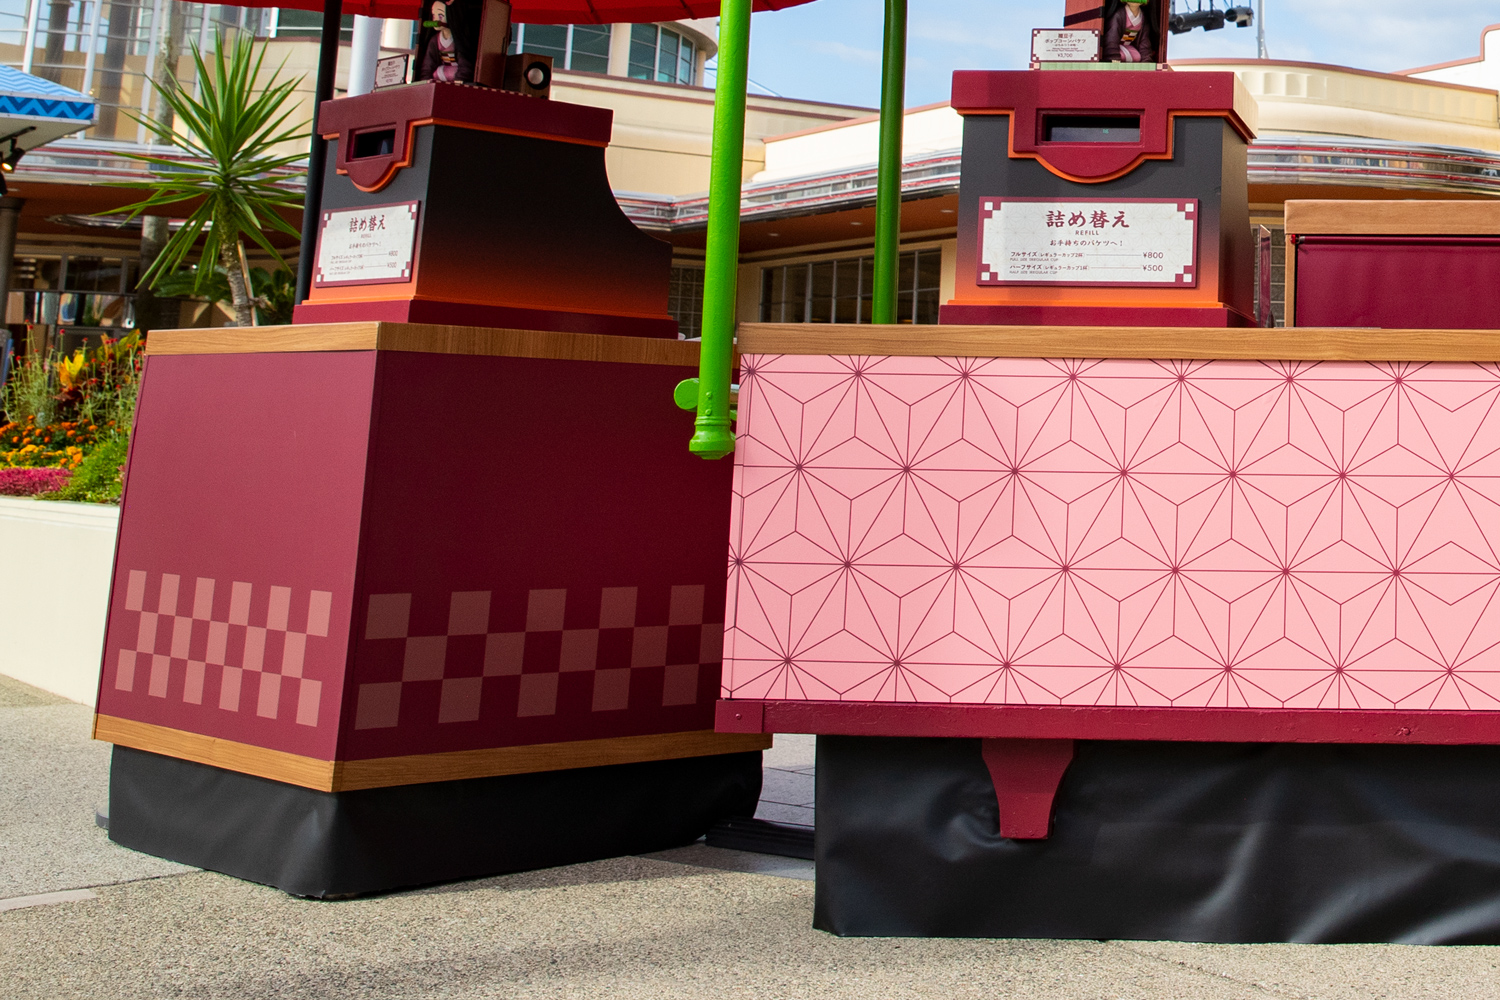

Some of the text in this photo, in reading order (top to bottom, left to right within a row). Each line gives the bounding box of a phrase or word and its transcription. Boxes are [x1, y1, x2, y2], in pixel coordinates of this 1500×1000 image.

[349, 214, 385, 232] 詰め替え
[1046, 210, 1129, 229] 詰め替え
